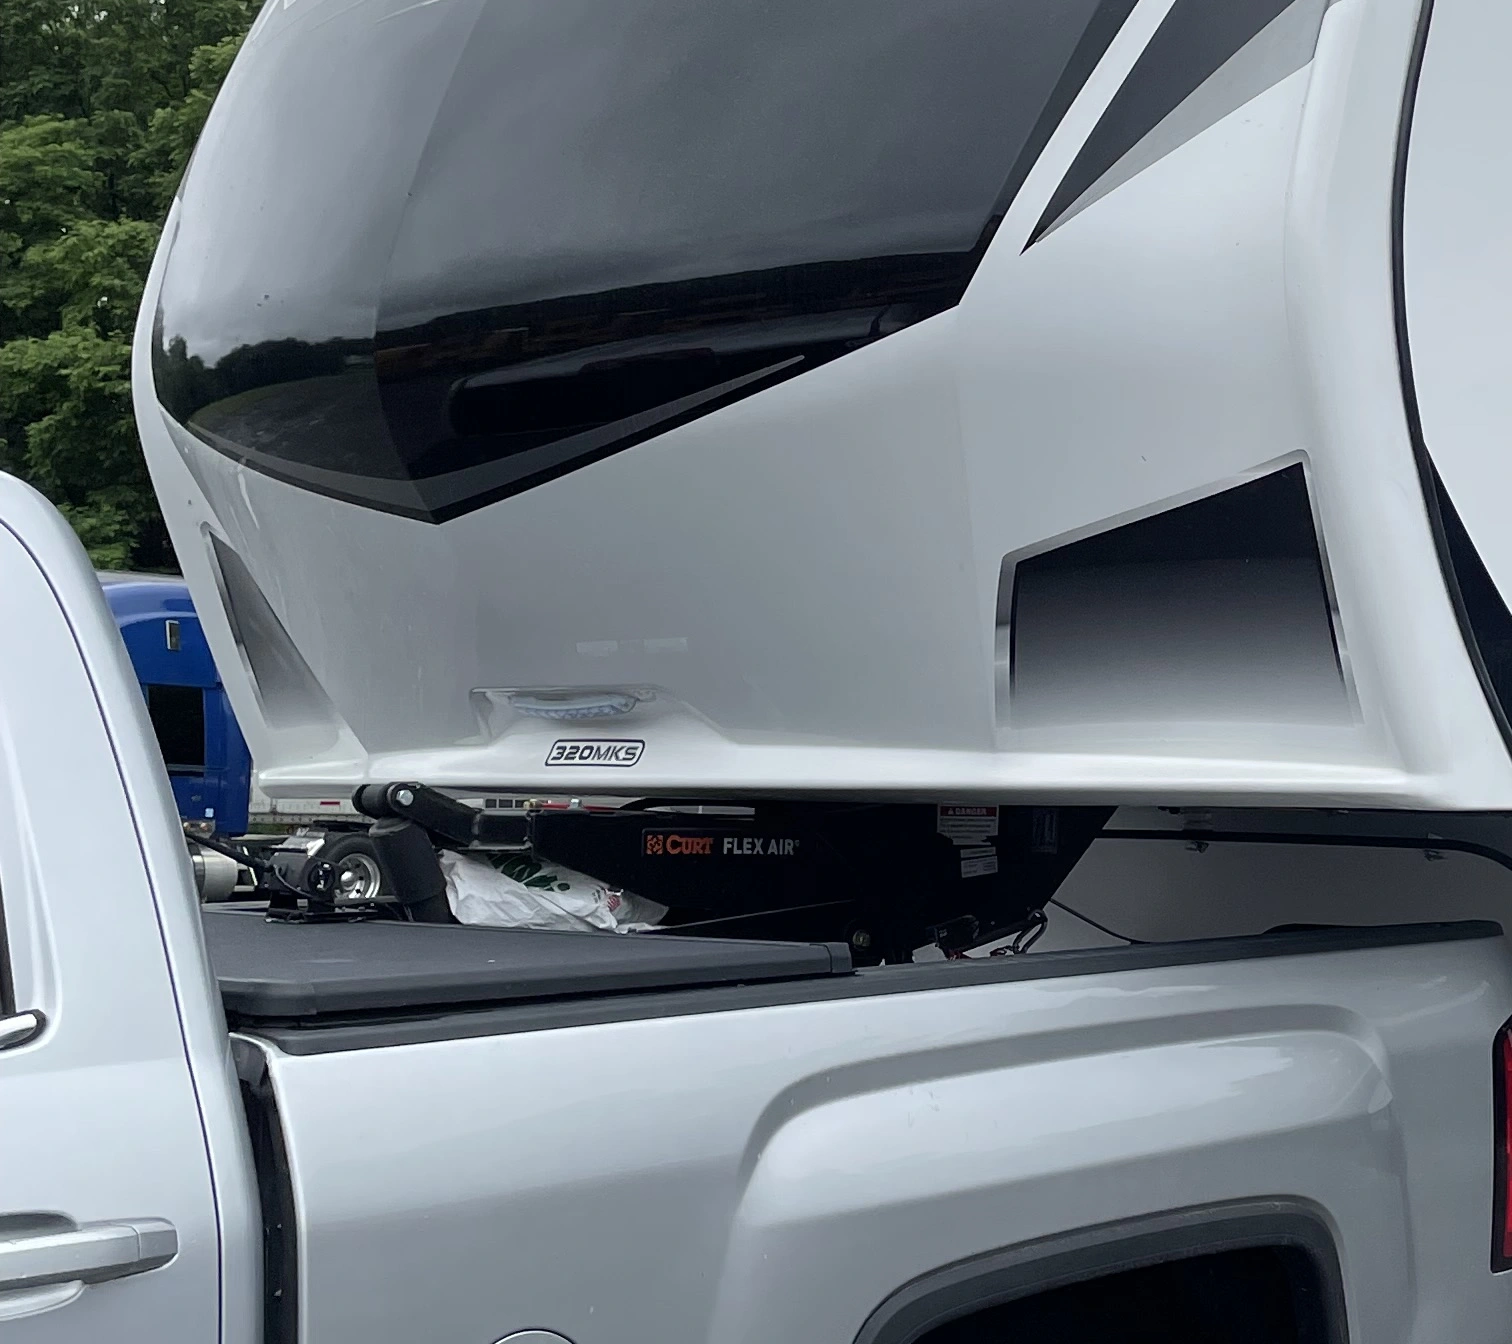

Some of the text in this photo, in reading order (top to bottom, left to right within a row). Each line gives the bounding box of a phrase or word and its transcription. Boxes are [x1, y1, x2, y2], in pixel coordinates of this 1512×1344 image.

[550, 745, 640, 761] 320MKS
[955, 807, 987, 816] DANGER
[666, 834, 714, 855] CURT
[723, 837, 764, 855] FLEX
